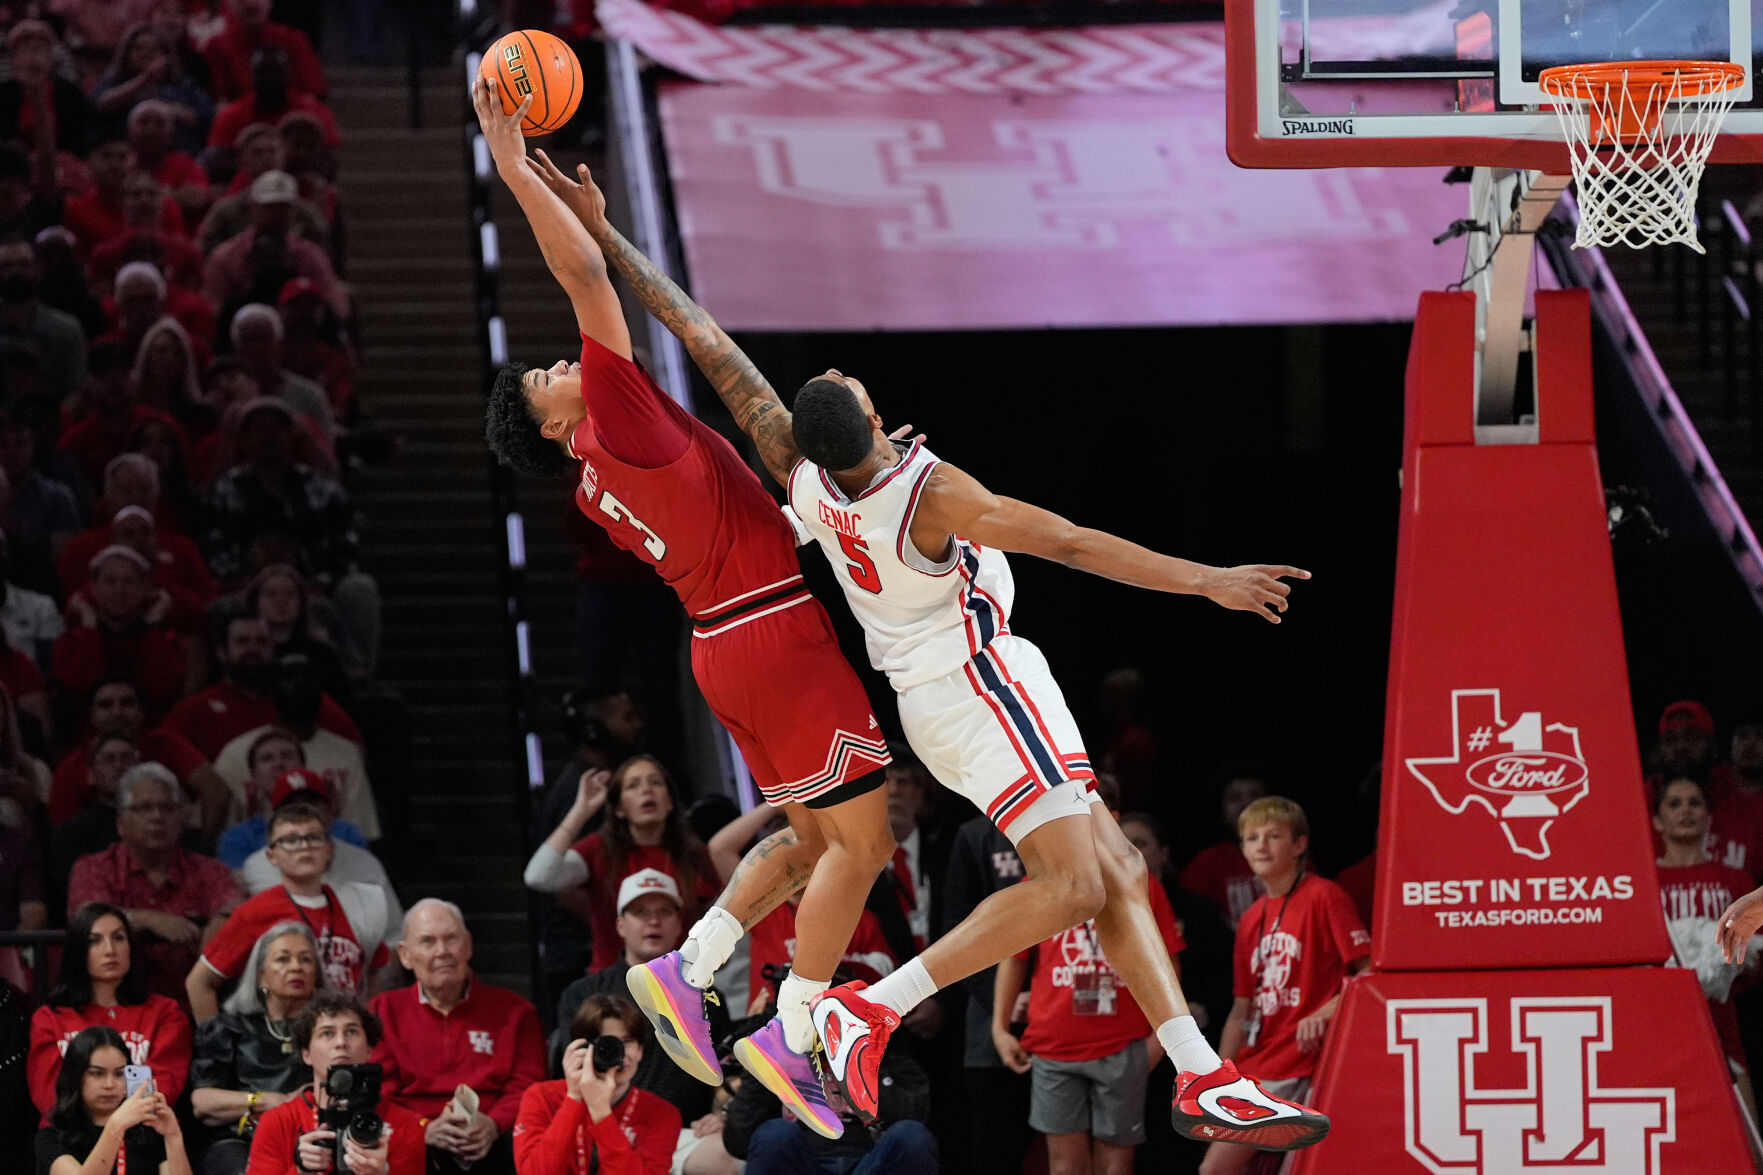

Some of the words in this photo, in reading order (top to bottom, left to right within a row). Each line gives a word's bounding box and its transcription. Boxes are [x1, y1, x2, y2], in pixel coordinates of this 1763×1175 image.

[1282, 119, 1353, 136] SPALDING
[599, 490, 667, 562] 3
[818, 499, 862, 539] CENAC
[835, 530, 883, 595] 5
[1488, 757, 1566, 788] Ford
[1403, 880, 1483, 905] BEST
[1490, 878, 1520, 902] IN
[1527, 875, 1634, 901] TEXAS
[1435, 907, 1602, 927] TEXASFORD.COM
